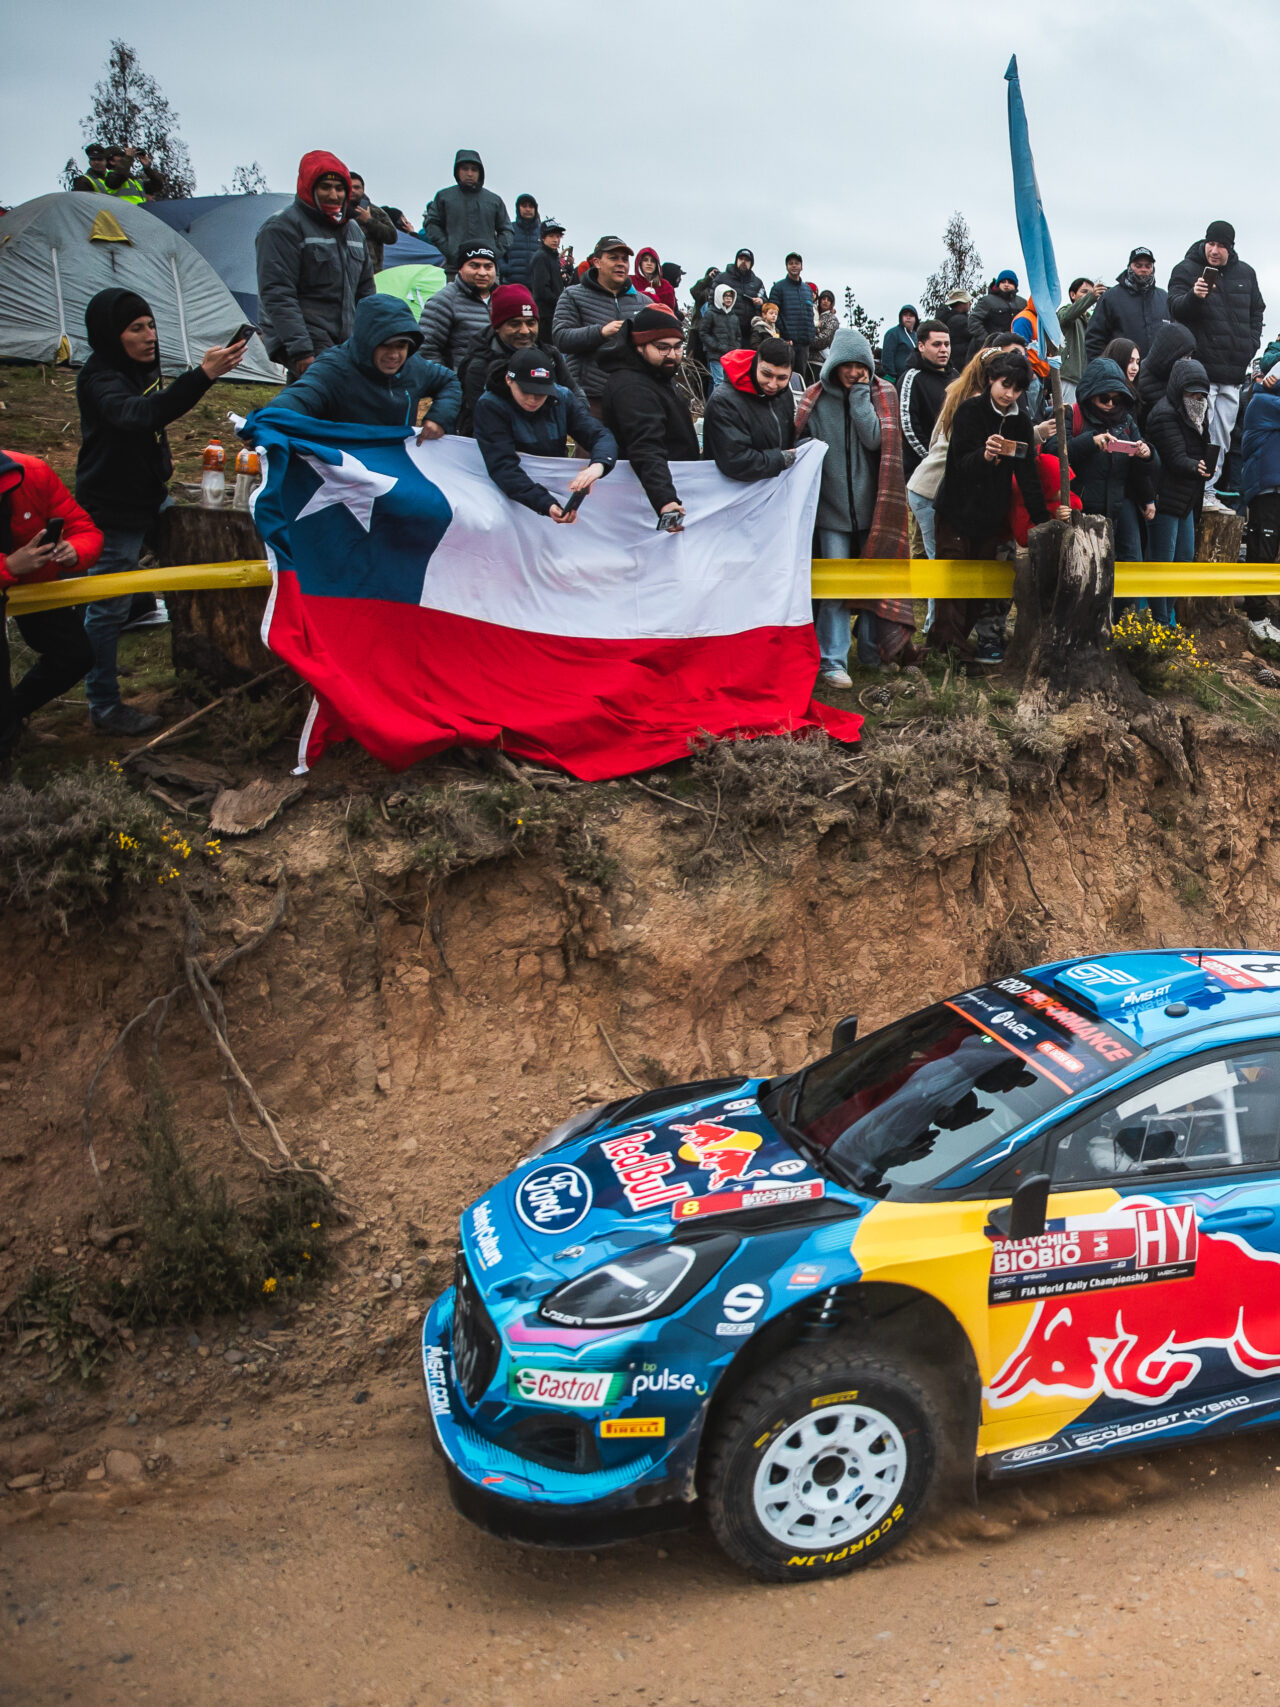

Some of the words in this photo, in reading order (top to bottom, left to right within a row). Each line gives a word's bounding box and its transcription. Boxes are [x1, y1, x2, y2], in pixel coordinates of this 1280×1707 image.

[992, 977, 1032, 994] FORD
[1016, 989, 1133, 1063] PERFORMANCE
[523, 1170, 583, 1223] Ford
[682, 1200, 699, 1215] 8
[993, 1231, 1080, 1253] RALLYCHILE
[1137, 1206, 1194, 1266] HY
[1021, 1287, 1037, 1297] FIA
[1038, 1283, 1065, 1295] World
[1066, 1280, 1088, 1291] Rally
[1089, 1272, 1149, 1287] Championship
[541, 1307, 583, 1326] LAZER
[643, 1362, 657, 1371] bp
[538, 1374, 604, 1401] Castrol
[632, 1368, 696, 1397] pulse
[606, 1421, 660, 1434] PIRELLI
[1075, 1413, 1180, 1447] ECOBOOST
[1183, 1396, 1251, 1419] HYBRID
